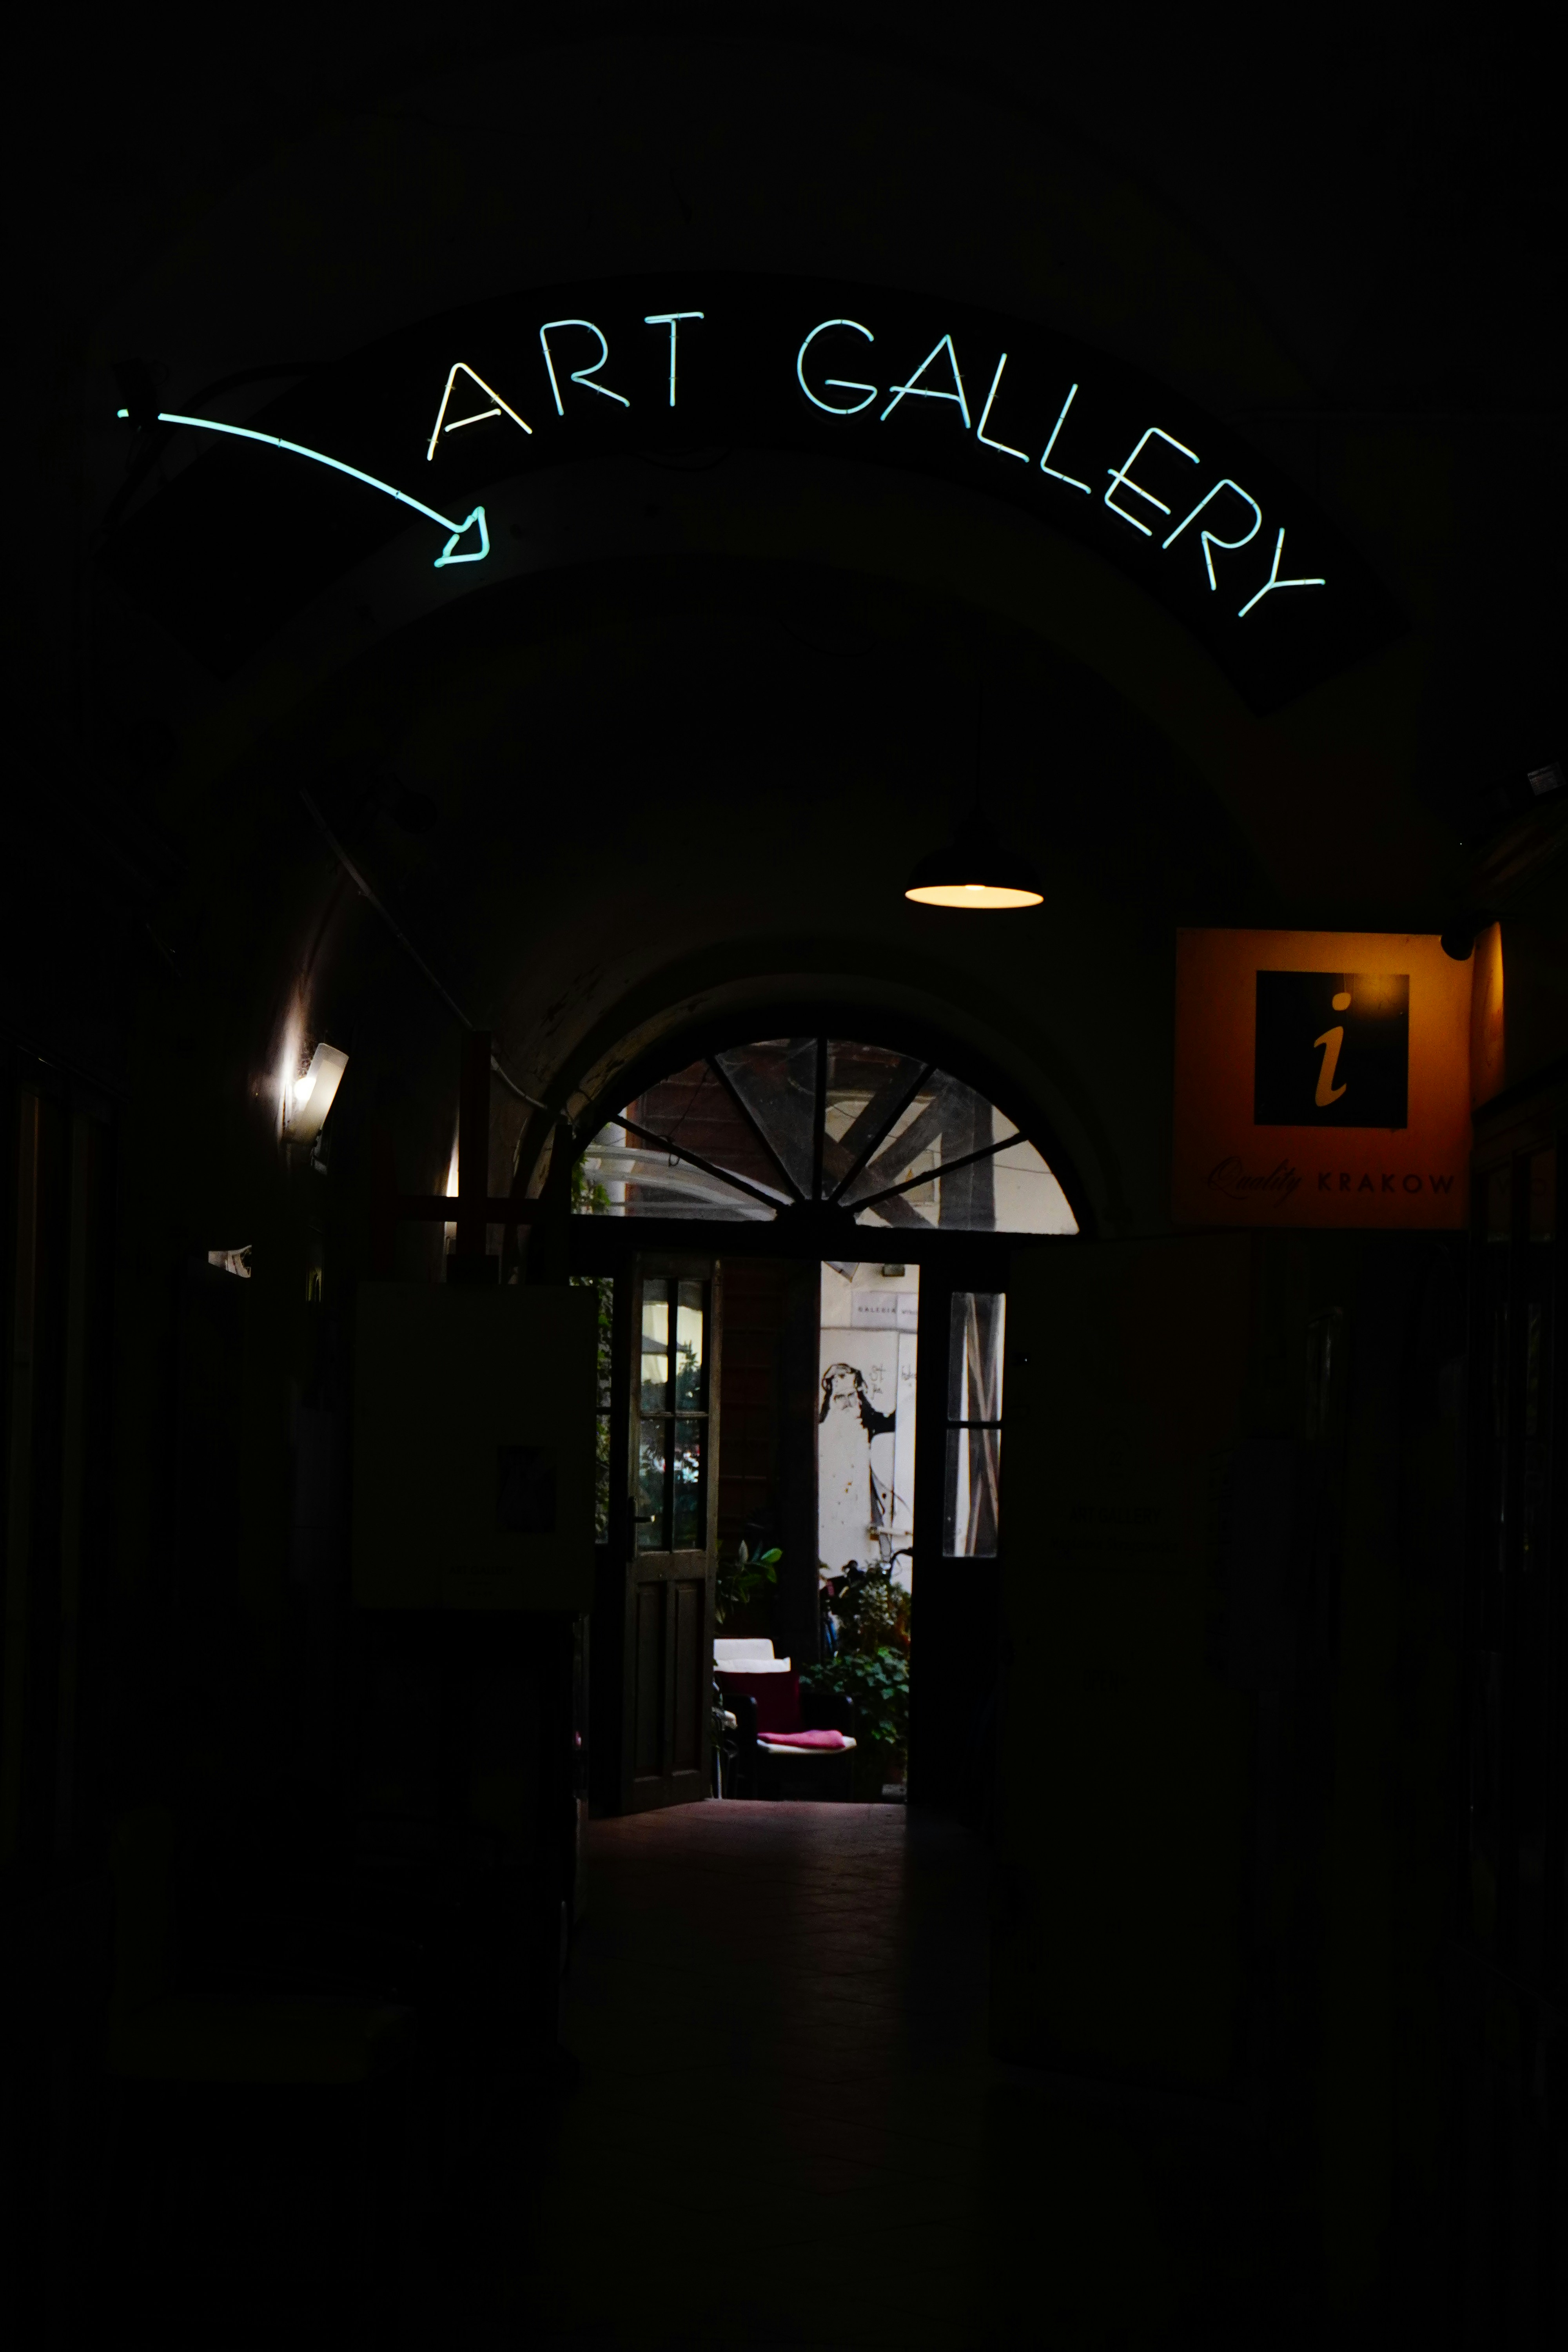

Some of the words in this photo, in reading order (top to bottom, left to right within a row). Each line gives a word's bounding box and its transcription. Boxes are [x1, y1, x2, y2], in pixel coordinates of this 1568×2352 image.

[426, 311, 704, 461] ART
[796, 319, 1326, 617] GALLERY
[1207, 1156, 1303, 1209] Quality
[1318, 1172, 1454, 1193] KRAKOW
[1109, 1450, 1124, 1466] 22
[1069, 1506, 1095, 1523] ART
[1098, 1507, 1162, 1524] GALLERY
[448, 1565, 468, 1575] ART
[470, 1565, 514, 1575] GALLERY
[1083, 1669, 1119, 1693] OPEN
